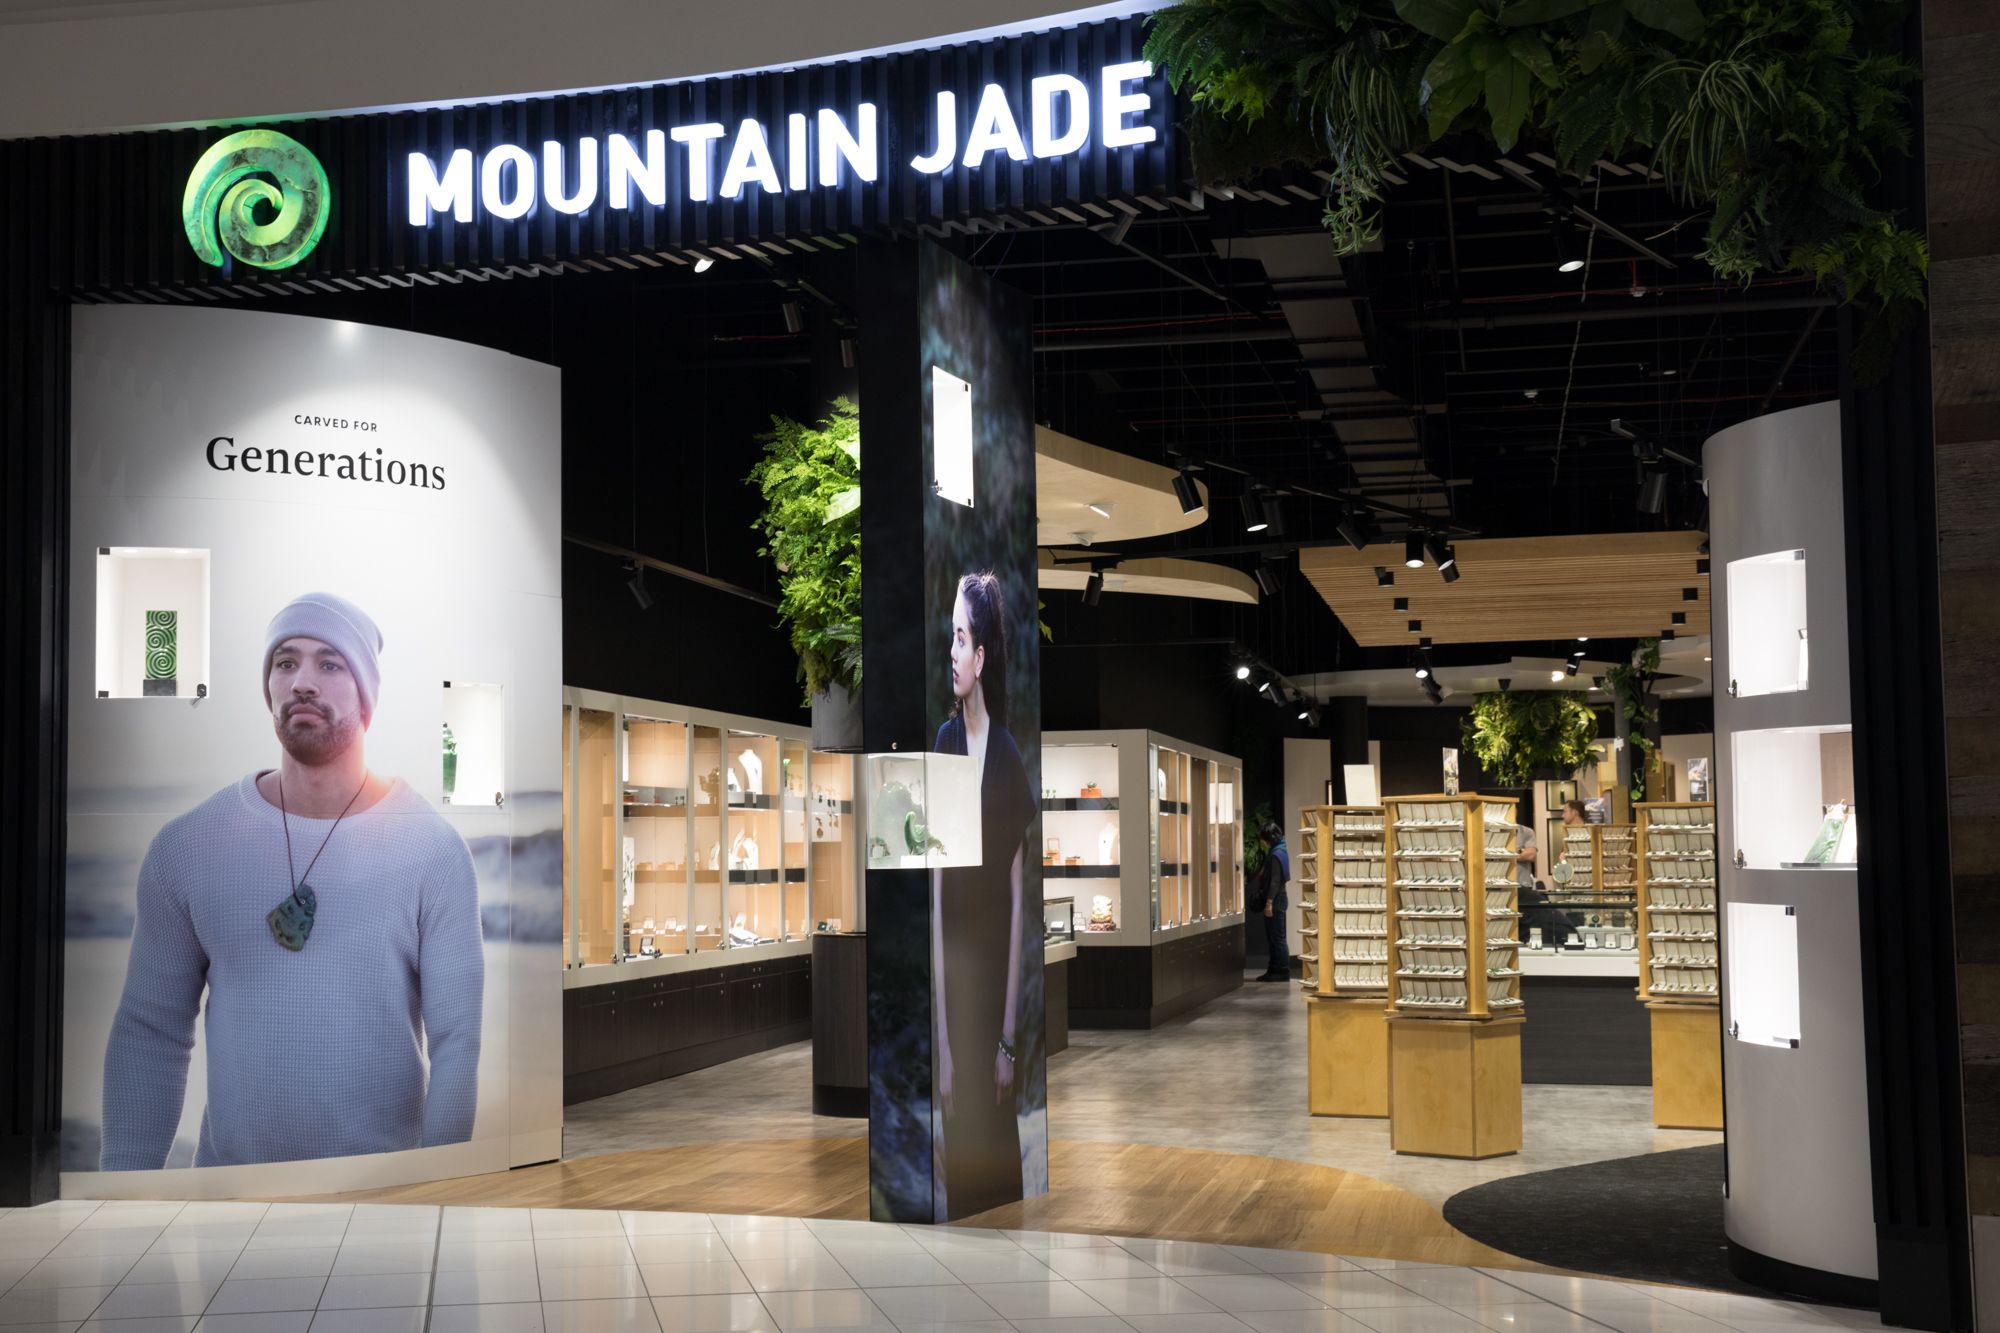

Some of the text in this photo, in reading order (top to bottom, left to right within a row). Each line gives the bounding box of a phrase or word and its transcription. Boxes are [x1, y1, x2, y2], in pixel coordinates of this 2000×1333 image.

[408, 59, 1157, 227] MOUNTAIN JADE
[294, 414, 378, 432] CARVED FOR
[205, 436, 446, 490] Generations
